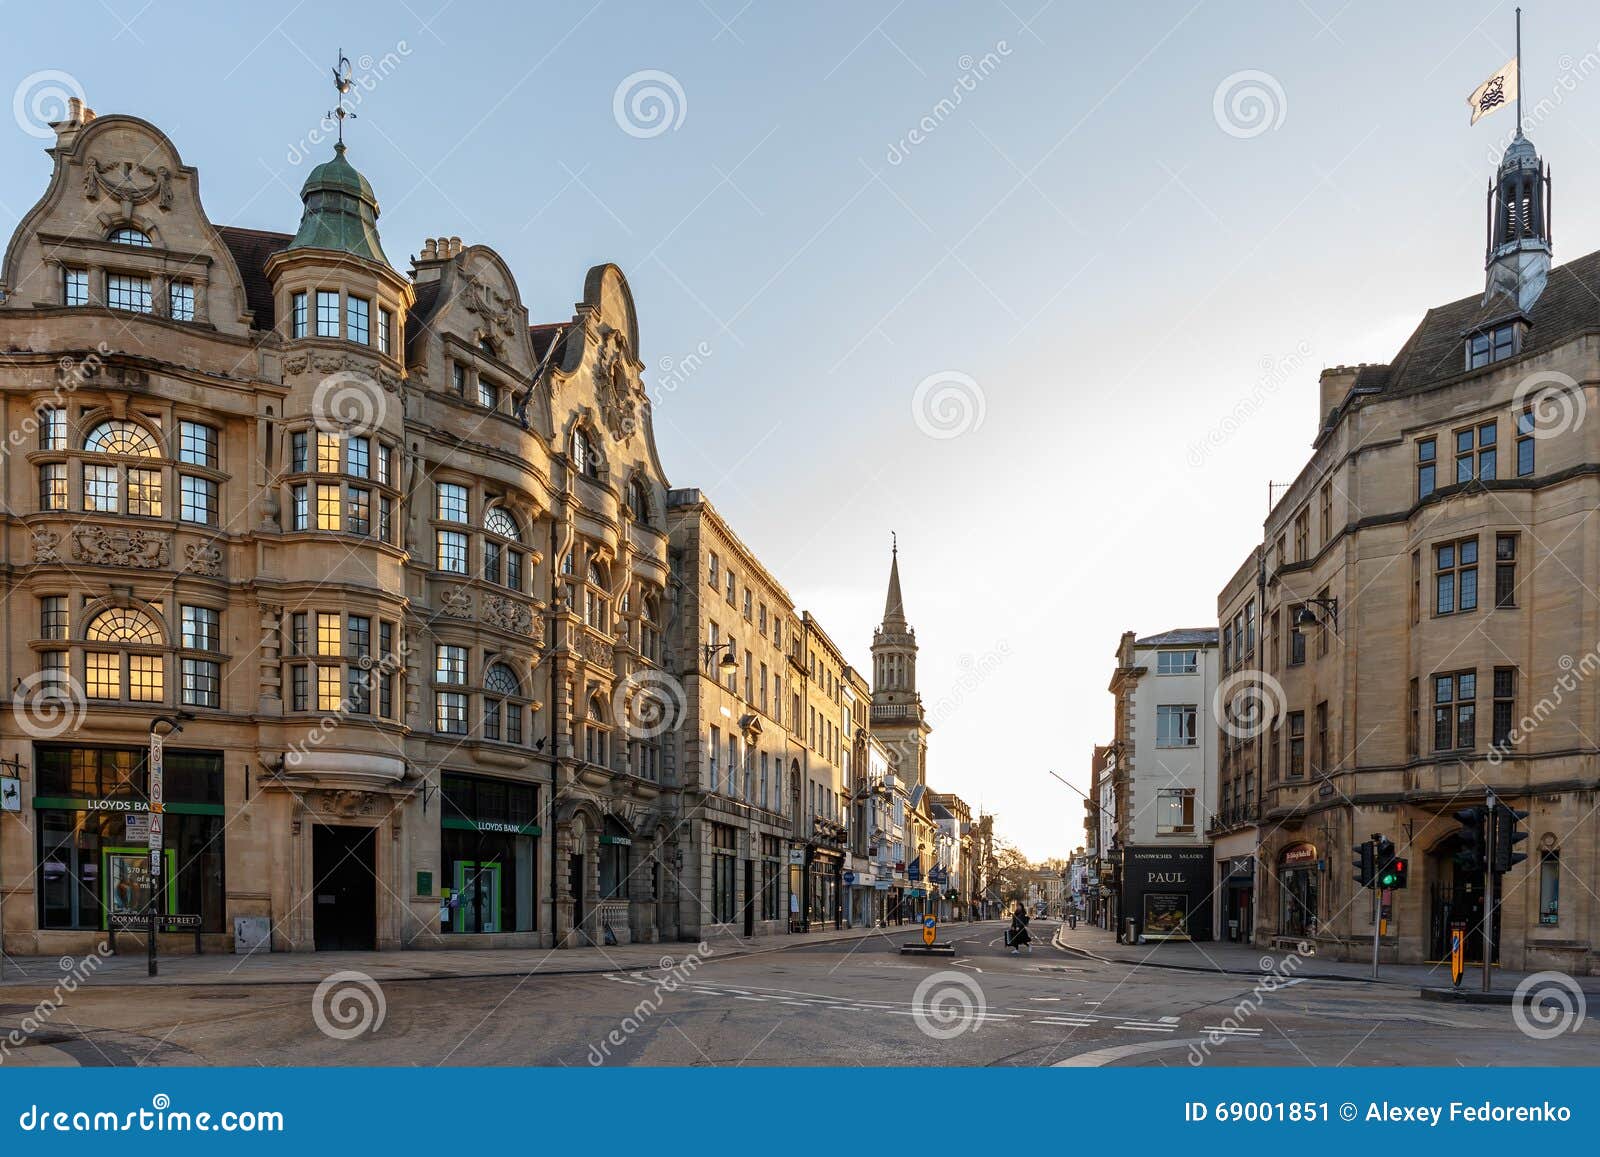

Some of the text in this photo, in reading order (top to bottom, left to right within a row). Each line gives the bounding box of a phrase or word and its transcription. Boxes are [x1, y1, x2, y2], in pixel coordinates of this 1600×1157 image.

[87, 799, 167, 812] LLOYDS BAK
[478, 821, 520, 833] LLOYDS BANK
[1147, 872, 1186, 883] PAUL
